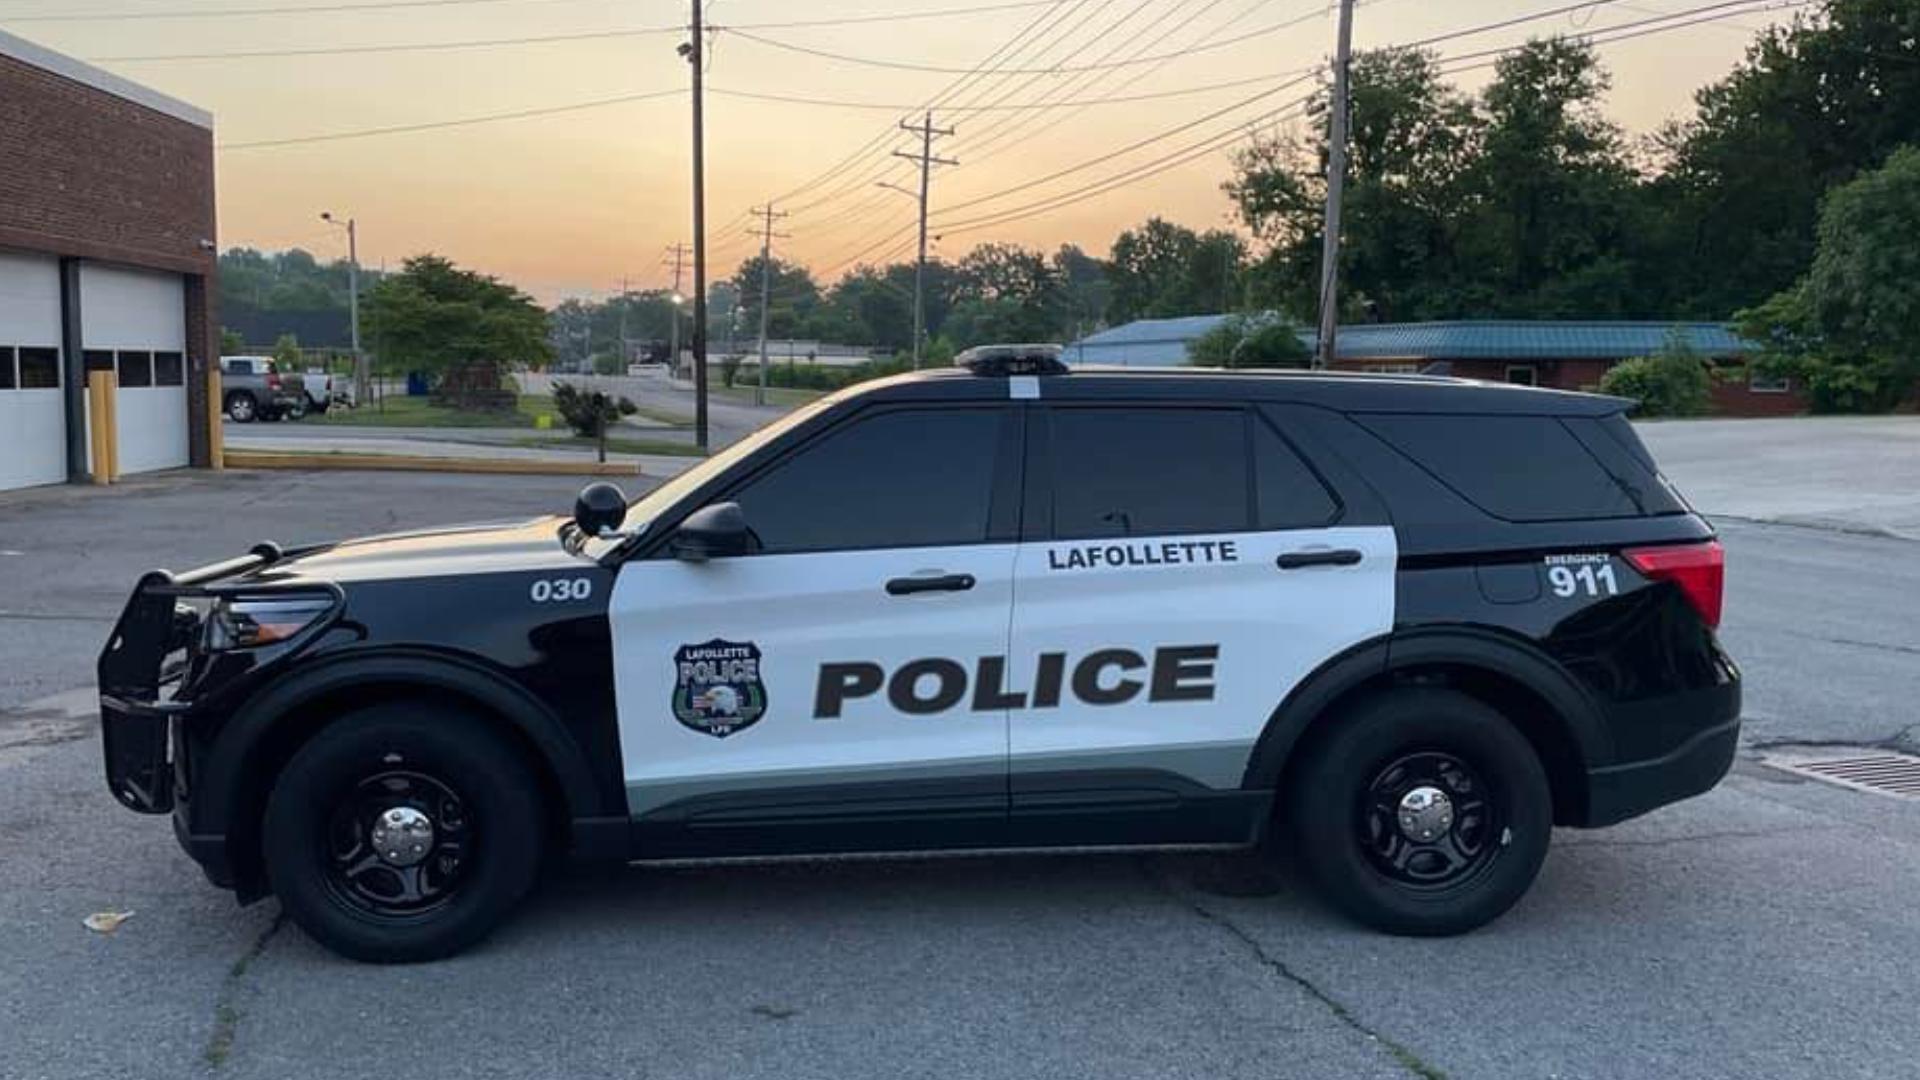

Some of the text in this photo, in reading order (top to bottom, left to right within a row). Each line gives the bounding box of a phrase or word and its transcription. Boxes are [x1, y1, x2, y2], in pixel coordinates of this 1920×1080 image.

[1048, 541, 1238, 570] LAFOLLETTE
[530, 578, 592, 602] 030
[1548, 564, 1619, 597] 911
[686, 647, 750, 659] LAFOLLETTE
[680, 658, 757, 685] POLICE
[813, 644, 1220, 719] POLICE
